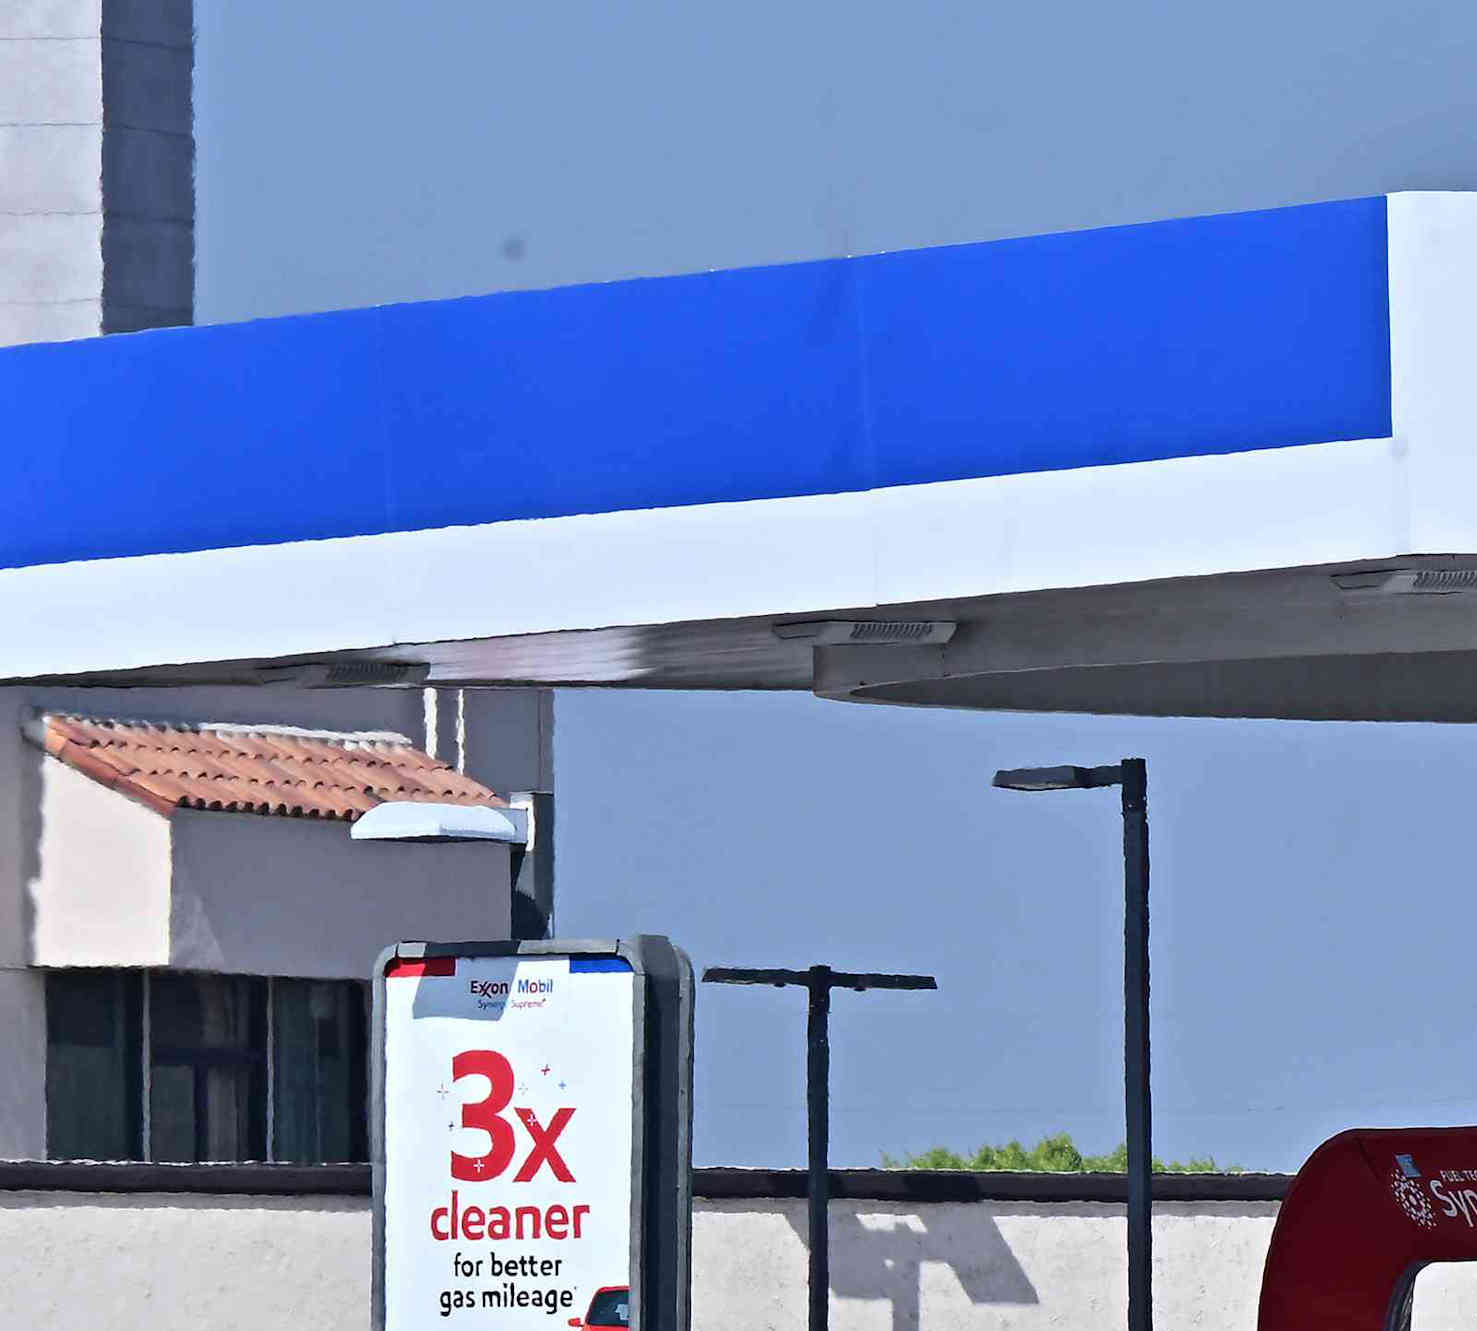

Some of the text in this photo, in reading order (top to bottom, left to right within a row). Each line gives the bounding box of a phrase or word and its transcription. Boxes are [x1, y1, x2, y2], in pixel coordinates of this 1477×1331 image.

[470, 979, 553, 998] Exxon Mobil
[450, 1049, 577, 1183] 3x
[1439, 1168, 1463, 1182] FUEL
[430, 1190, 591, 1241] cleaner
[453, 1252, 563, 1278] for better
[439, 1290, 476, 1316] gas
